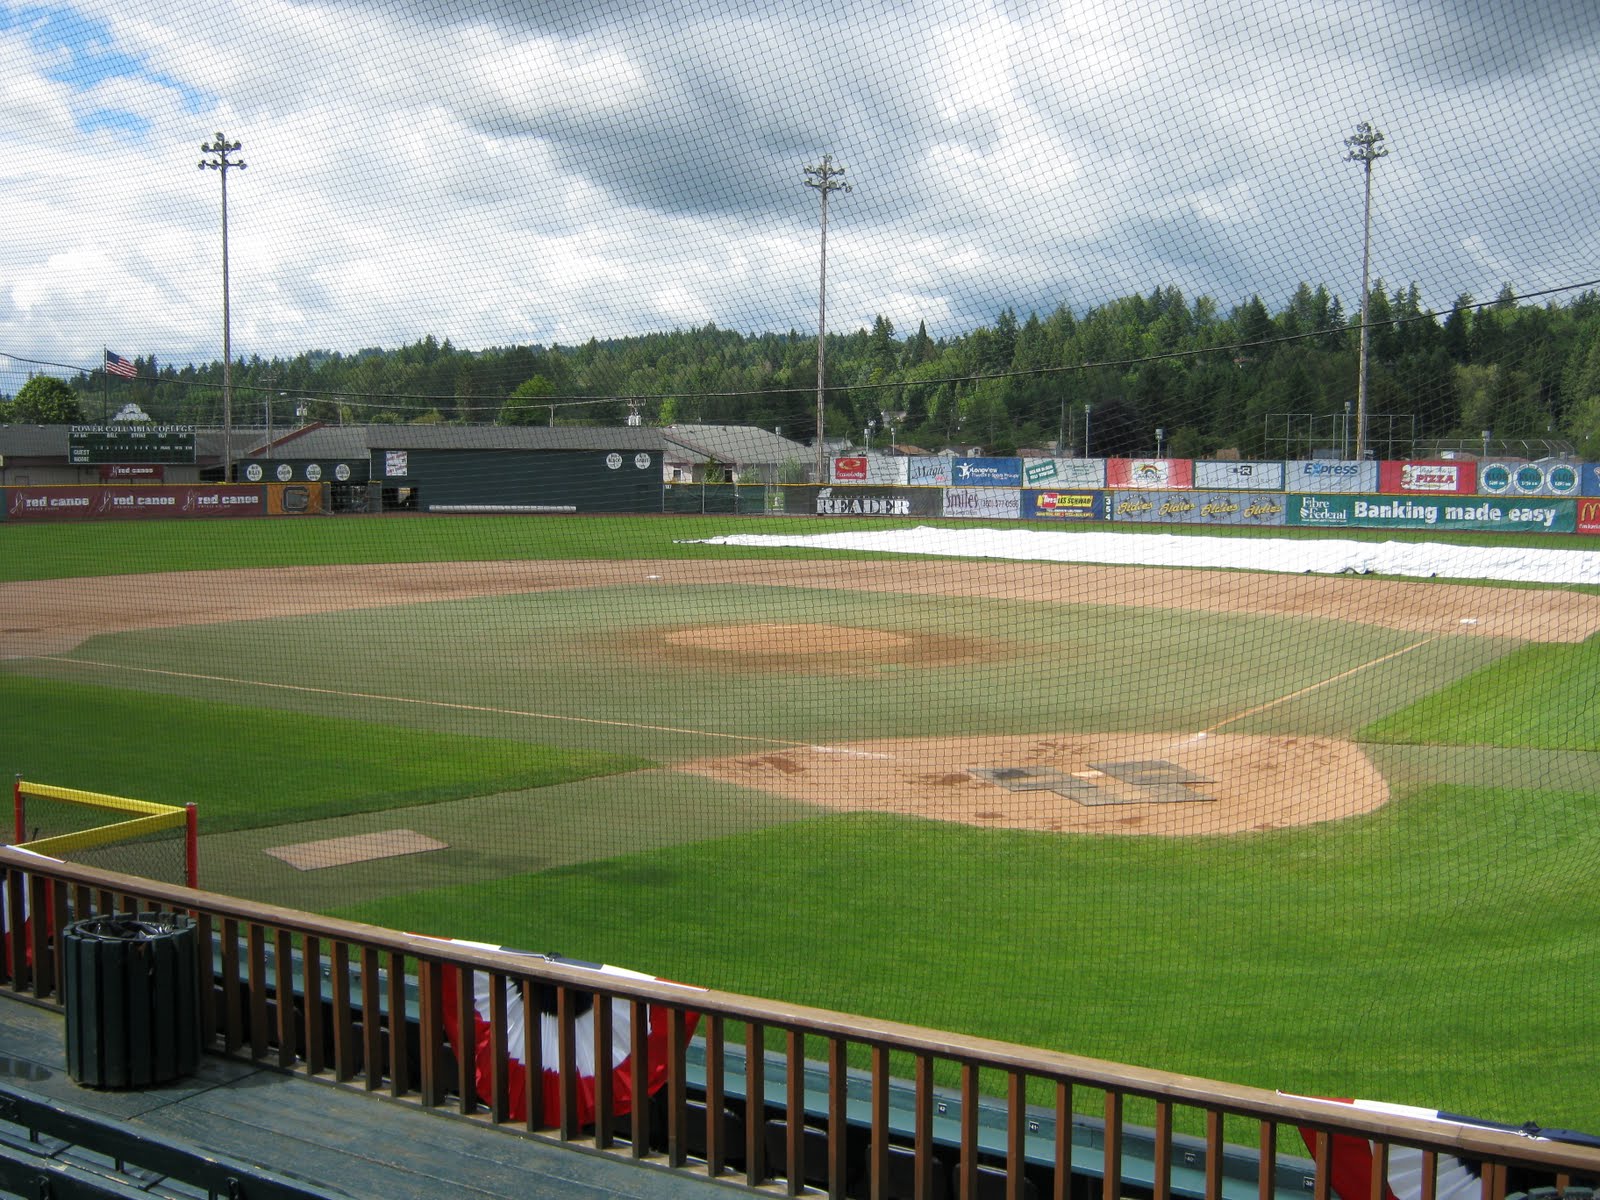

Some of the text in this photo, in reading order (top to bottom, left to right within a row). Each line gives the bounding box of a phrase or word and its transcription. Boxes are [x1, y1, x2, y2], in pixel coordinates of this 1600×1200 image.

[912, 466, 946, 479] Magic
[1304, 462, 1358, 476] Express
[1415, 475, 1455, 483] PIZZA
[26, 496, 90, 506] red canoe
[114, 496, 176, 505] red canoe
[197, 495, 259, 504] red canoe
[946, 490, 978, 508] Smiles
[1058, 496, 1068, 504] LES
[1302, 496, 1329, 508] Fibre
[816, 498, 910, 514] READER
[1117, 500, 1154, 514] Oldies
[1158, 501, 1196, 516] Oldies
[1200, 501, 1240, 517] Oldies
[1242, 502, 1283, 518] Oldies
[1309, 508, 1346, 520] Federal
[1354, 501, 1556, 526] Banking made easy
